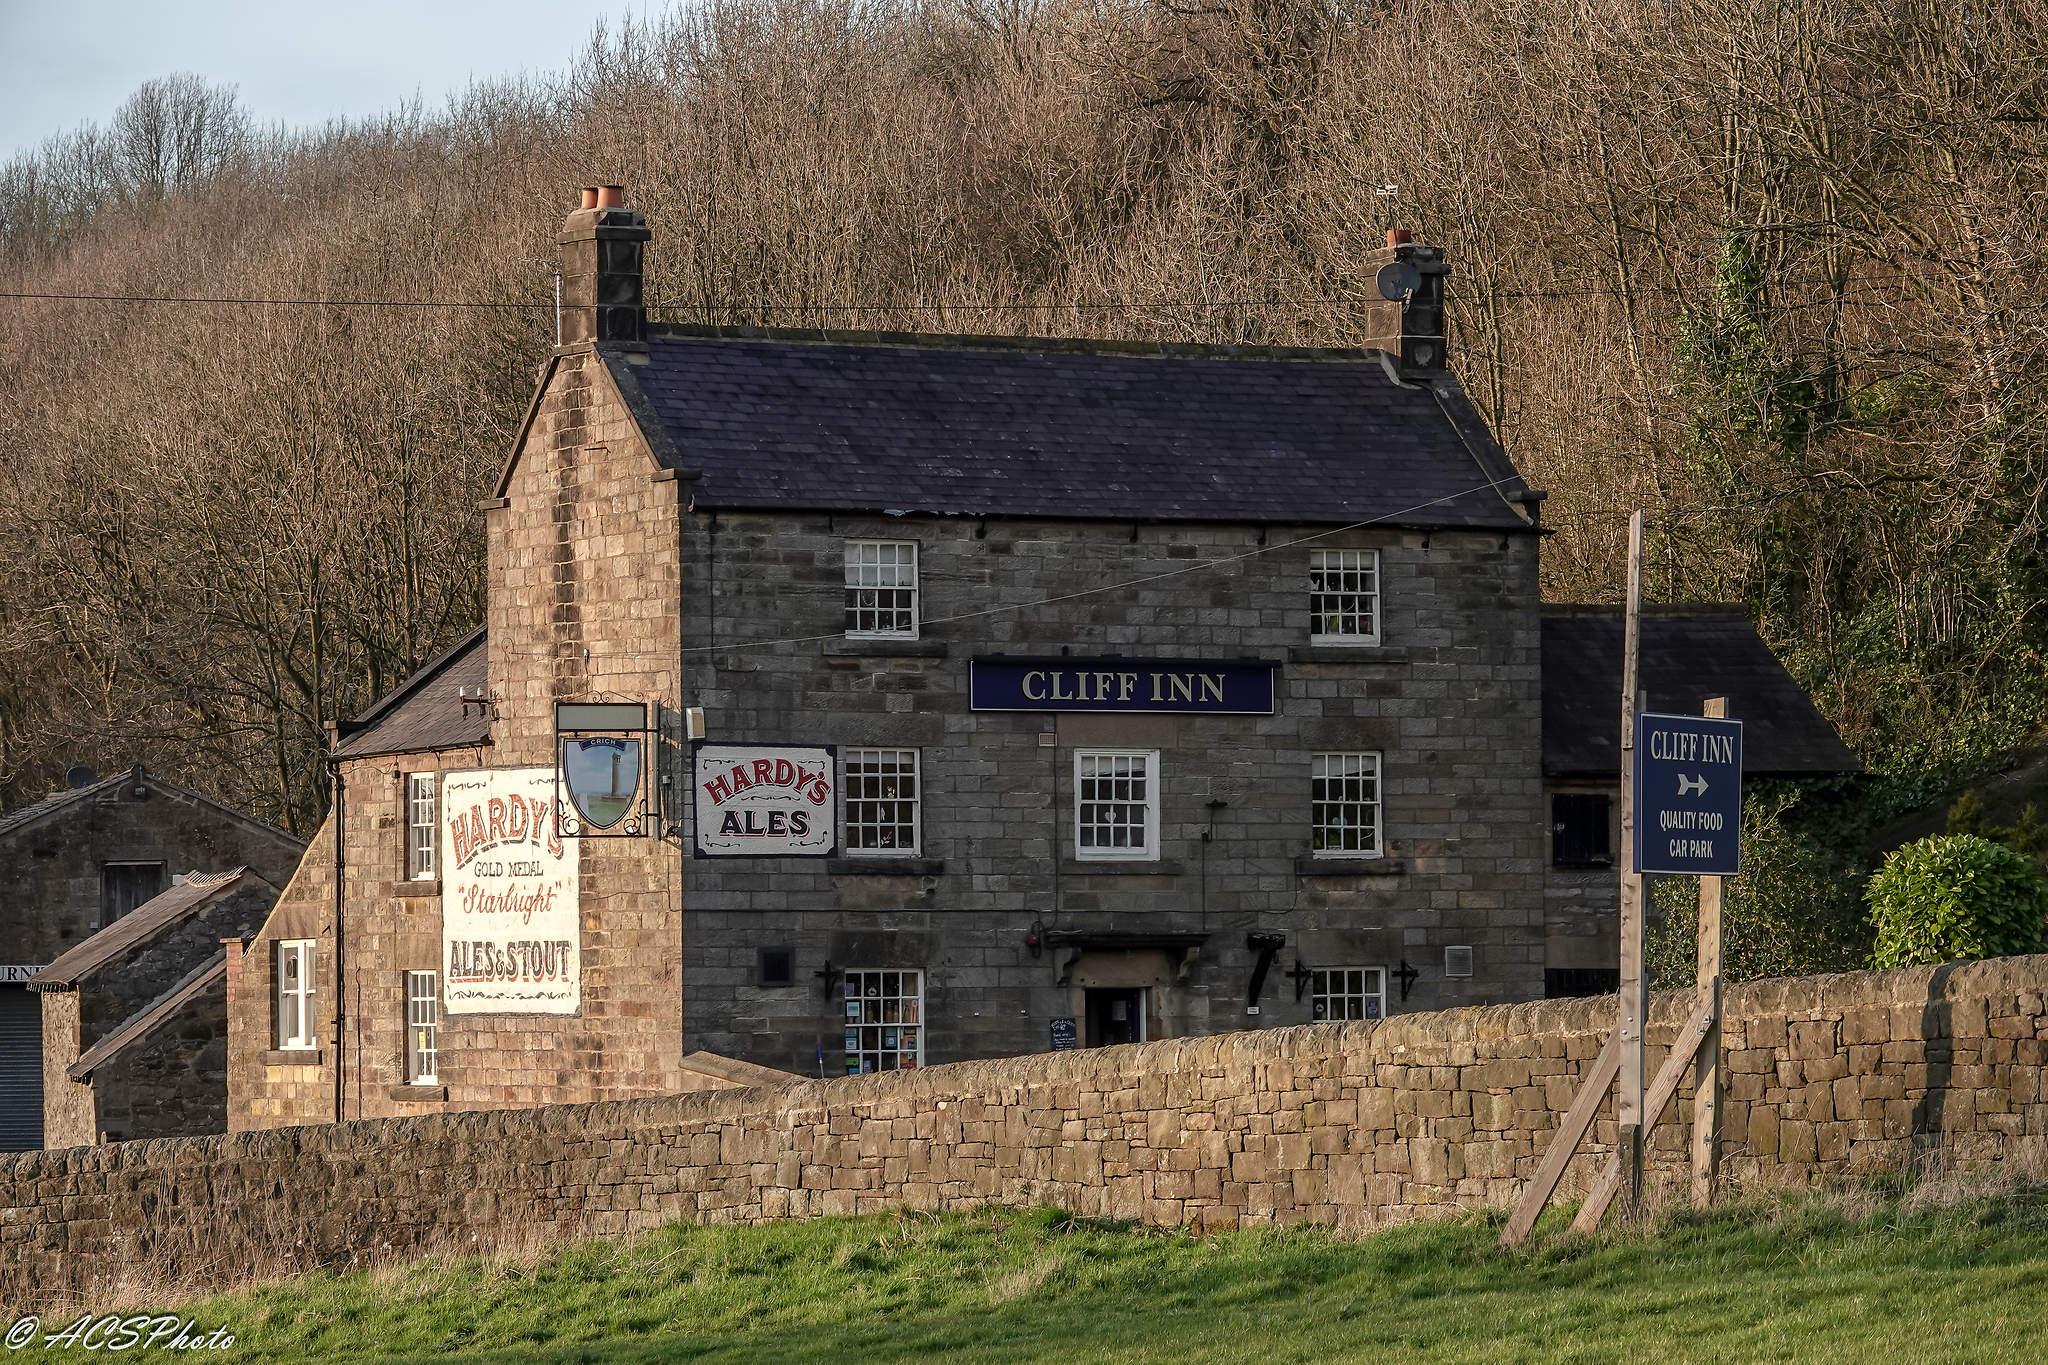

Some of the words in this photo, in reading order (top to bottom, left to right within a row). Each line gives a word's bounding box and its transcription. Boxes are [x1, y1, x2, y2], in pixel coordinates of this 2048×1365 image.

[1022, 671, 1138, 700] CLIFF
[1150, 673, 1226, 702] INN
[1650, 730, 1698, 761] CLIFF
[1702, 735, 1734, 764] INN
[703, 758, 831, 806] HARDY'S
[720, 811, 810, 837] ALES
[1660, 810, 1696, 831] QUALITY
[1698, 812, 1723, 831] FOOD
[1669, 839, 1687, 857] CAR
[1690, 840, 1713, 858] PARK
[474, 861, 503, 877] GOLD
[508, 861, 544, 877] MEDAL
